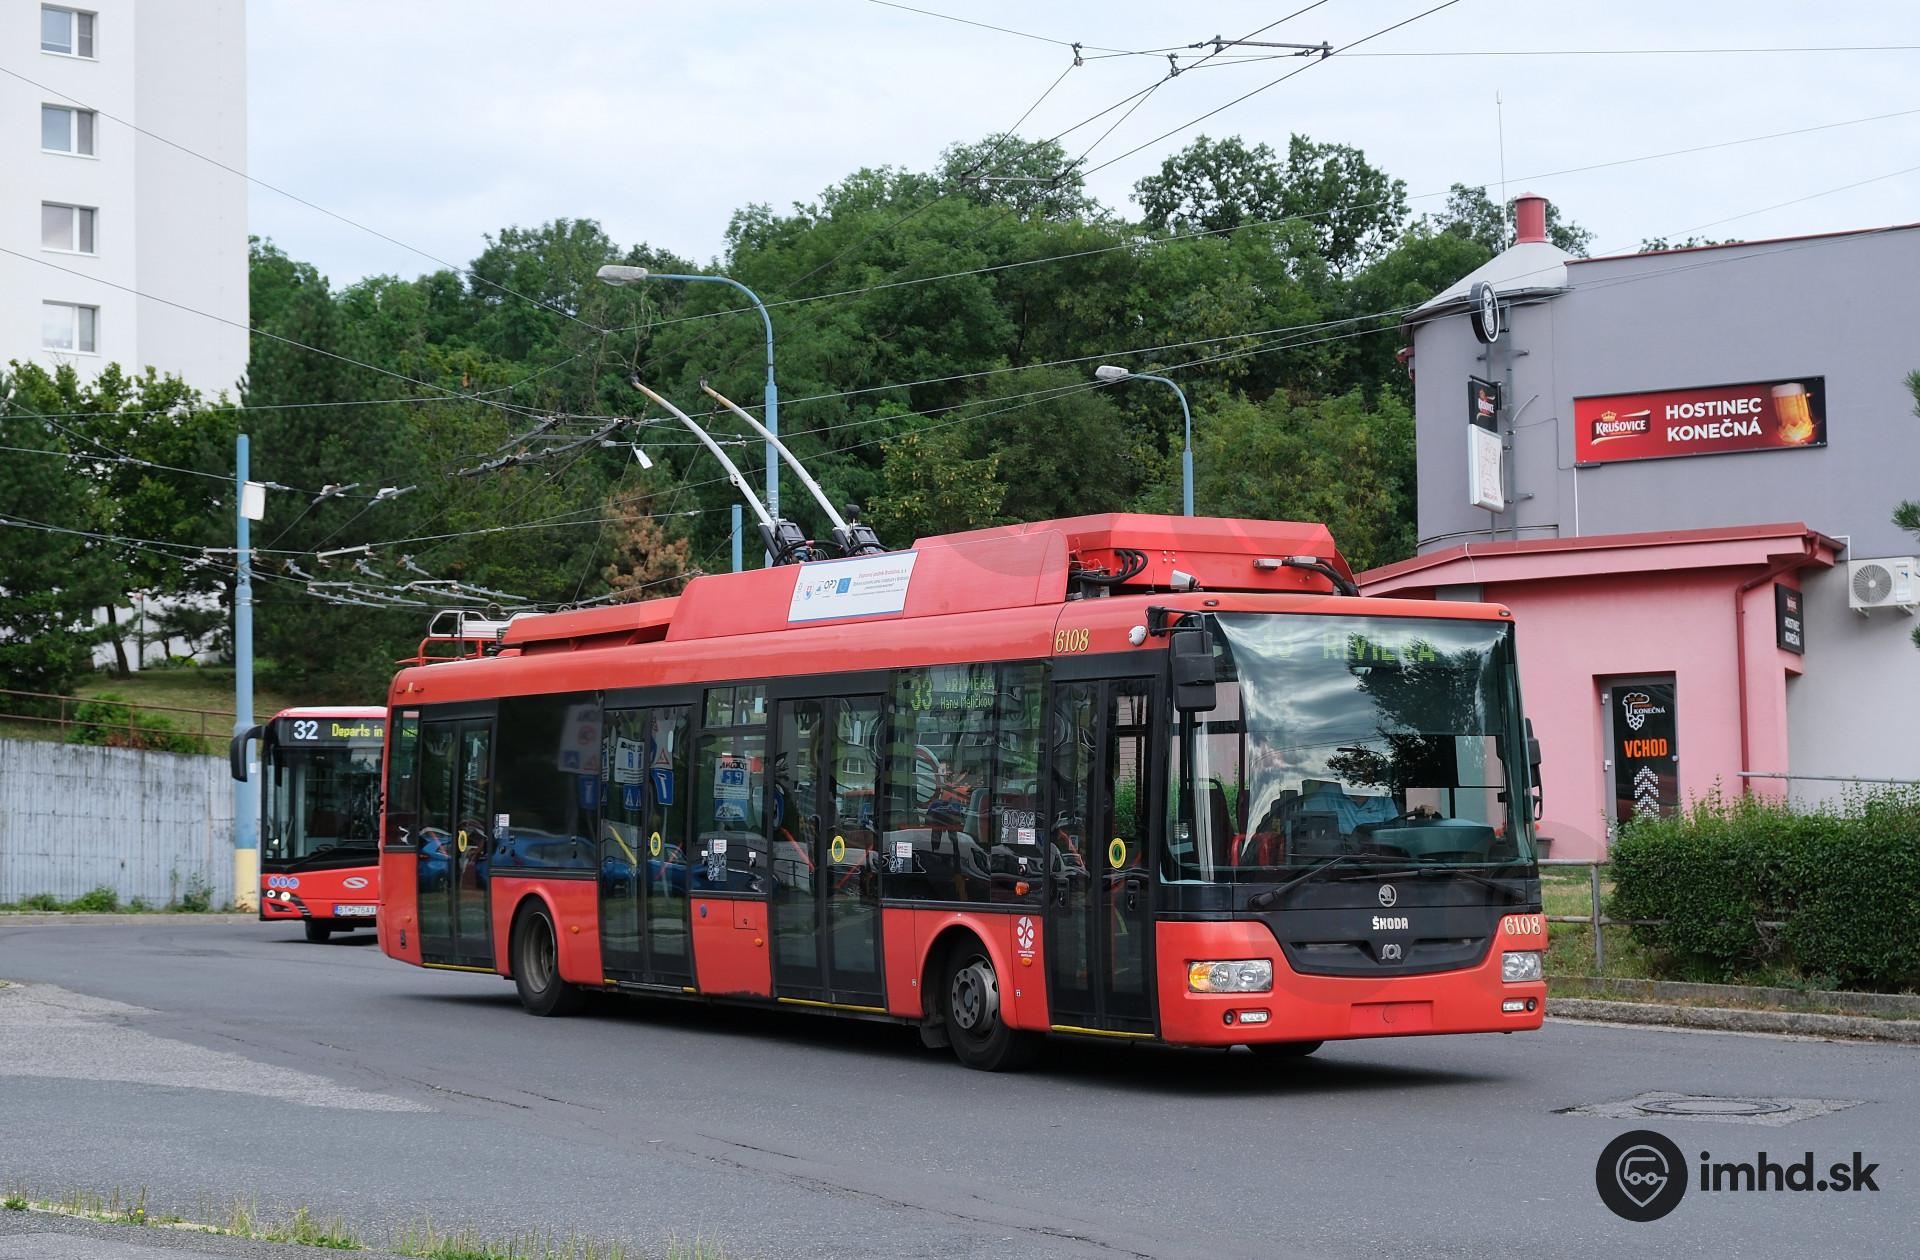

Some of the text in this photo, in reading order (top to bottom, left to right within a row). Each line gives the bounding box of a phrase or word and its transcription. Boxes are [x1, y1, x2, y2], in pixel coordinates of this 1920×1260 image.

[1665, 397, 1762, 420] HOSTINEC
[1595, 419, 1646, 436] KRUŠOVICE
[1667, 416, 1762, 442] KONEČNÁ
[1055, 628, 1089, 653] 6108
[1633, 704, 1666, 715] KONEČNÁ
[293, 720, 384, 740] 32 Departs in
[1623, 738, 1668, 759] VCHOD
[1372, 915, 1409, 930] ŠKODA
[1504, 916, 1541, 936] 6108
